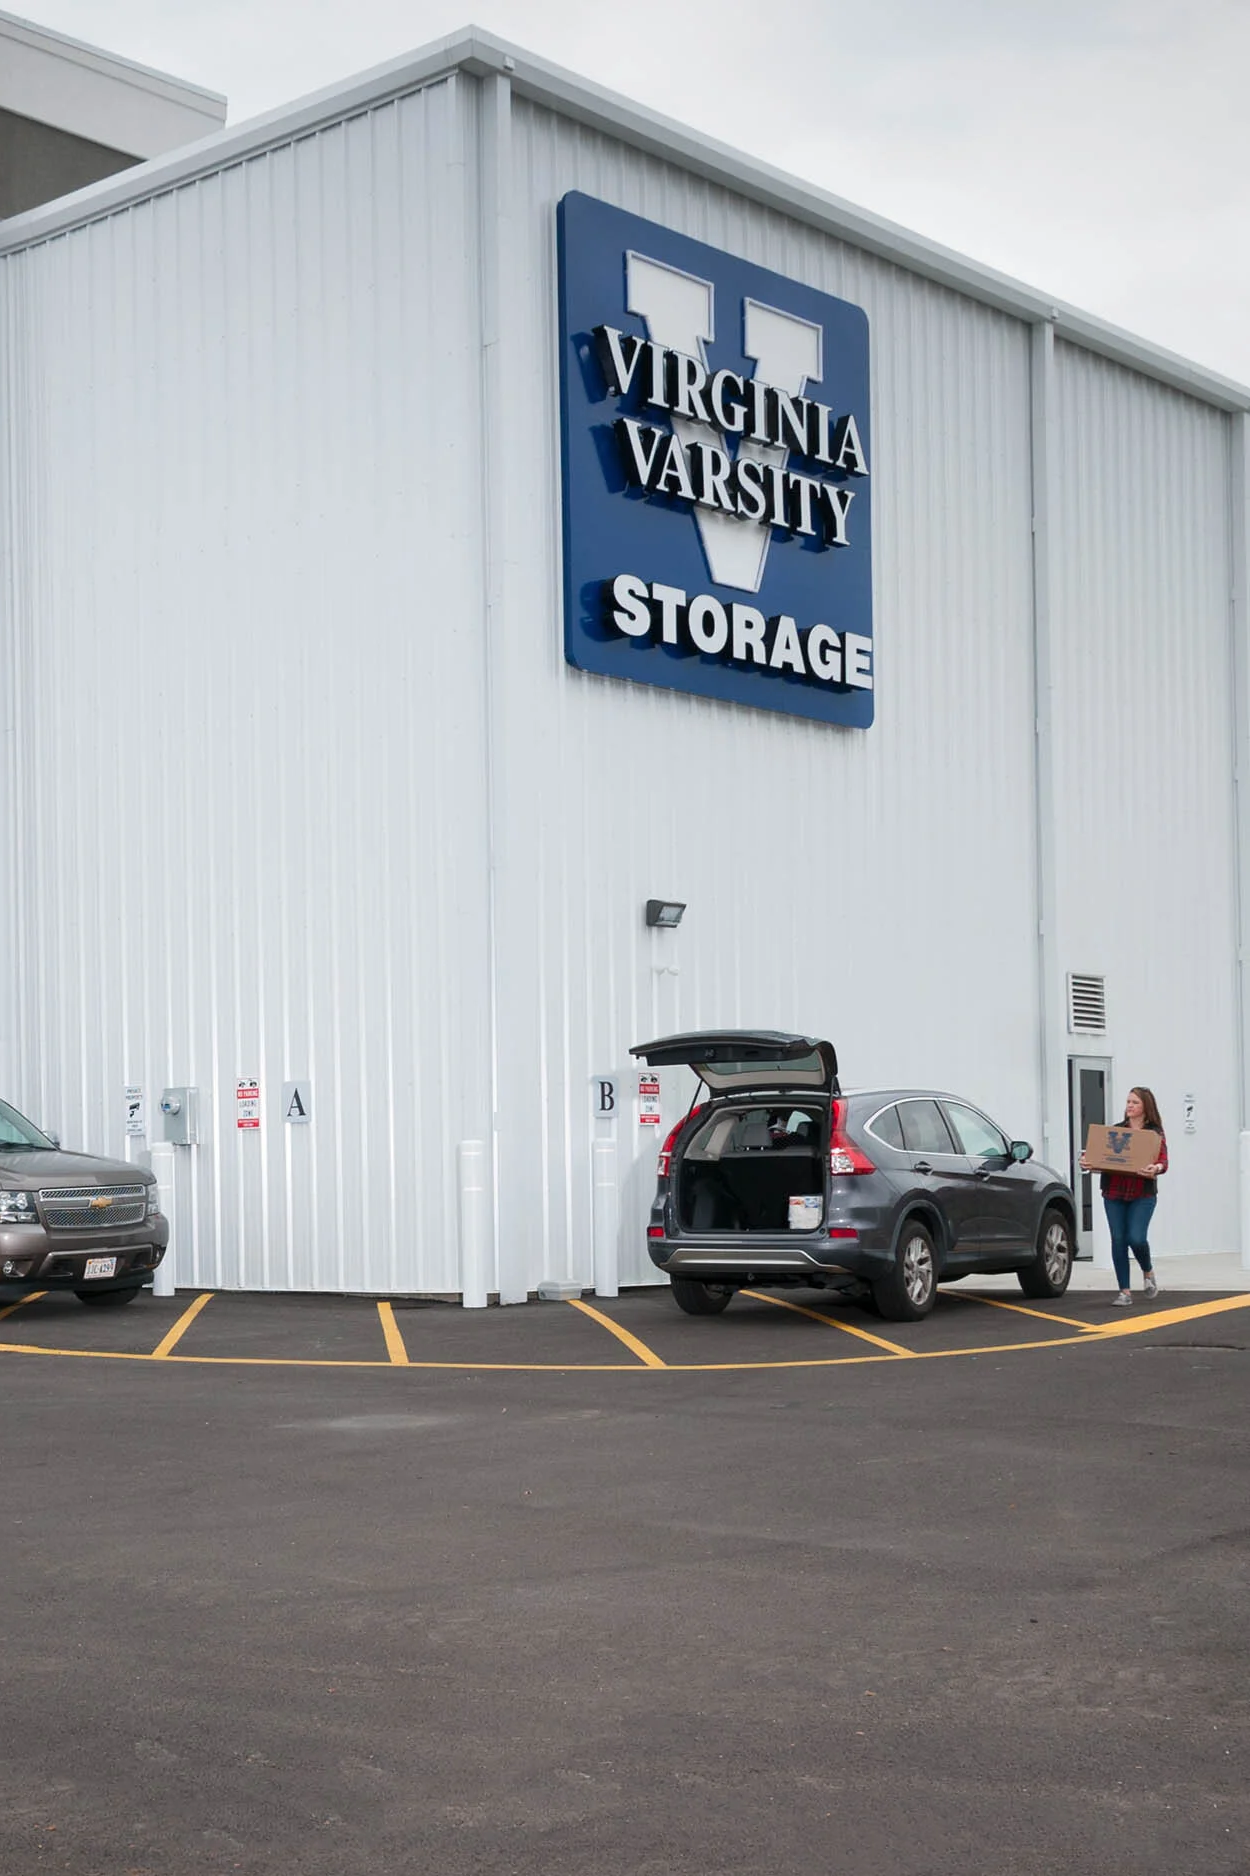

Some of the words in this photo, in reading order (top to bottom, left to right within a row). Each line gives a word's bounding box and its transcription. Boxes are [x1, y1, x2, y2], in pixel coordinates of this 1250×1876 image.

[601, 324, 869, 477] VIRGINIA
[622, 417, 856, 546] VARSITY
[613, 573, 874, 690] STORAGE
[287, 1088, 306, 1117] A
[598, 1081, 615, 1111] B
